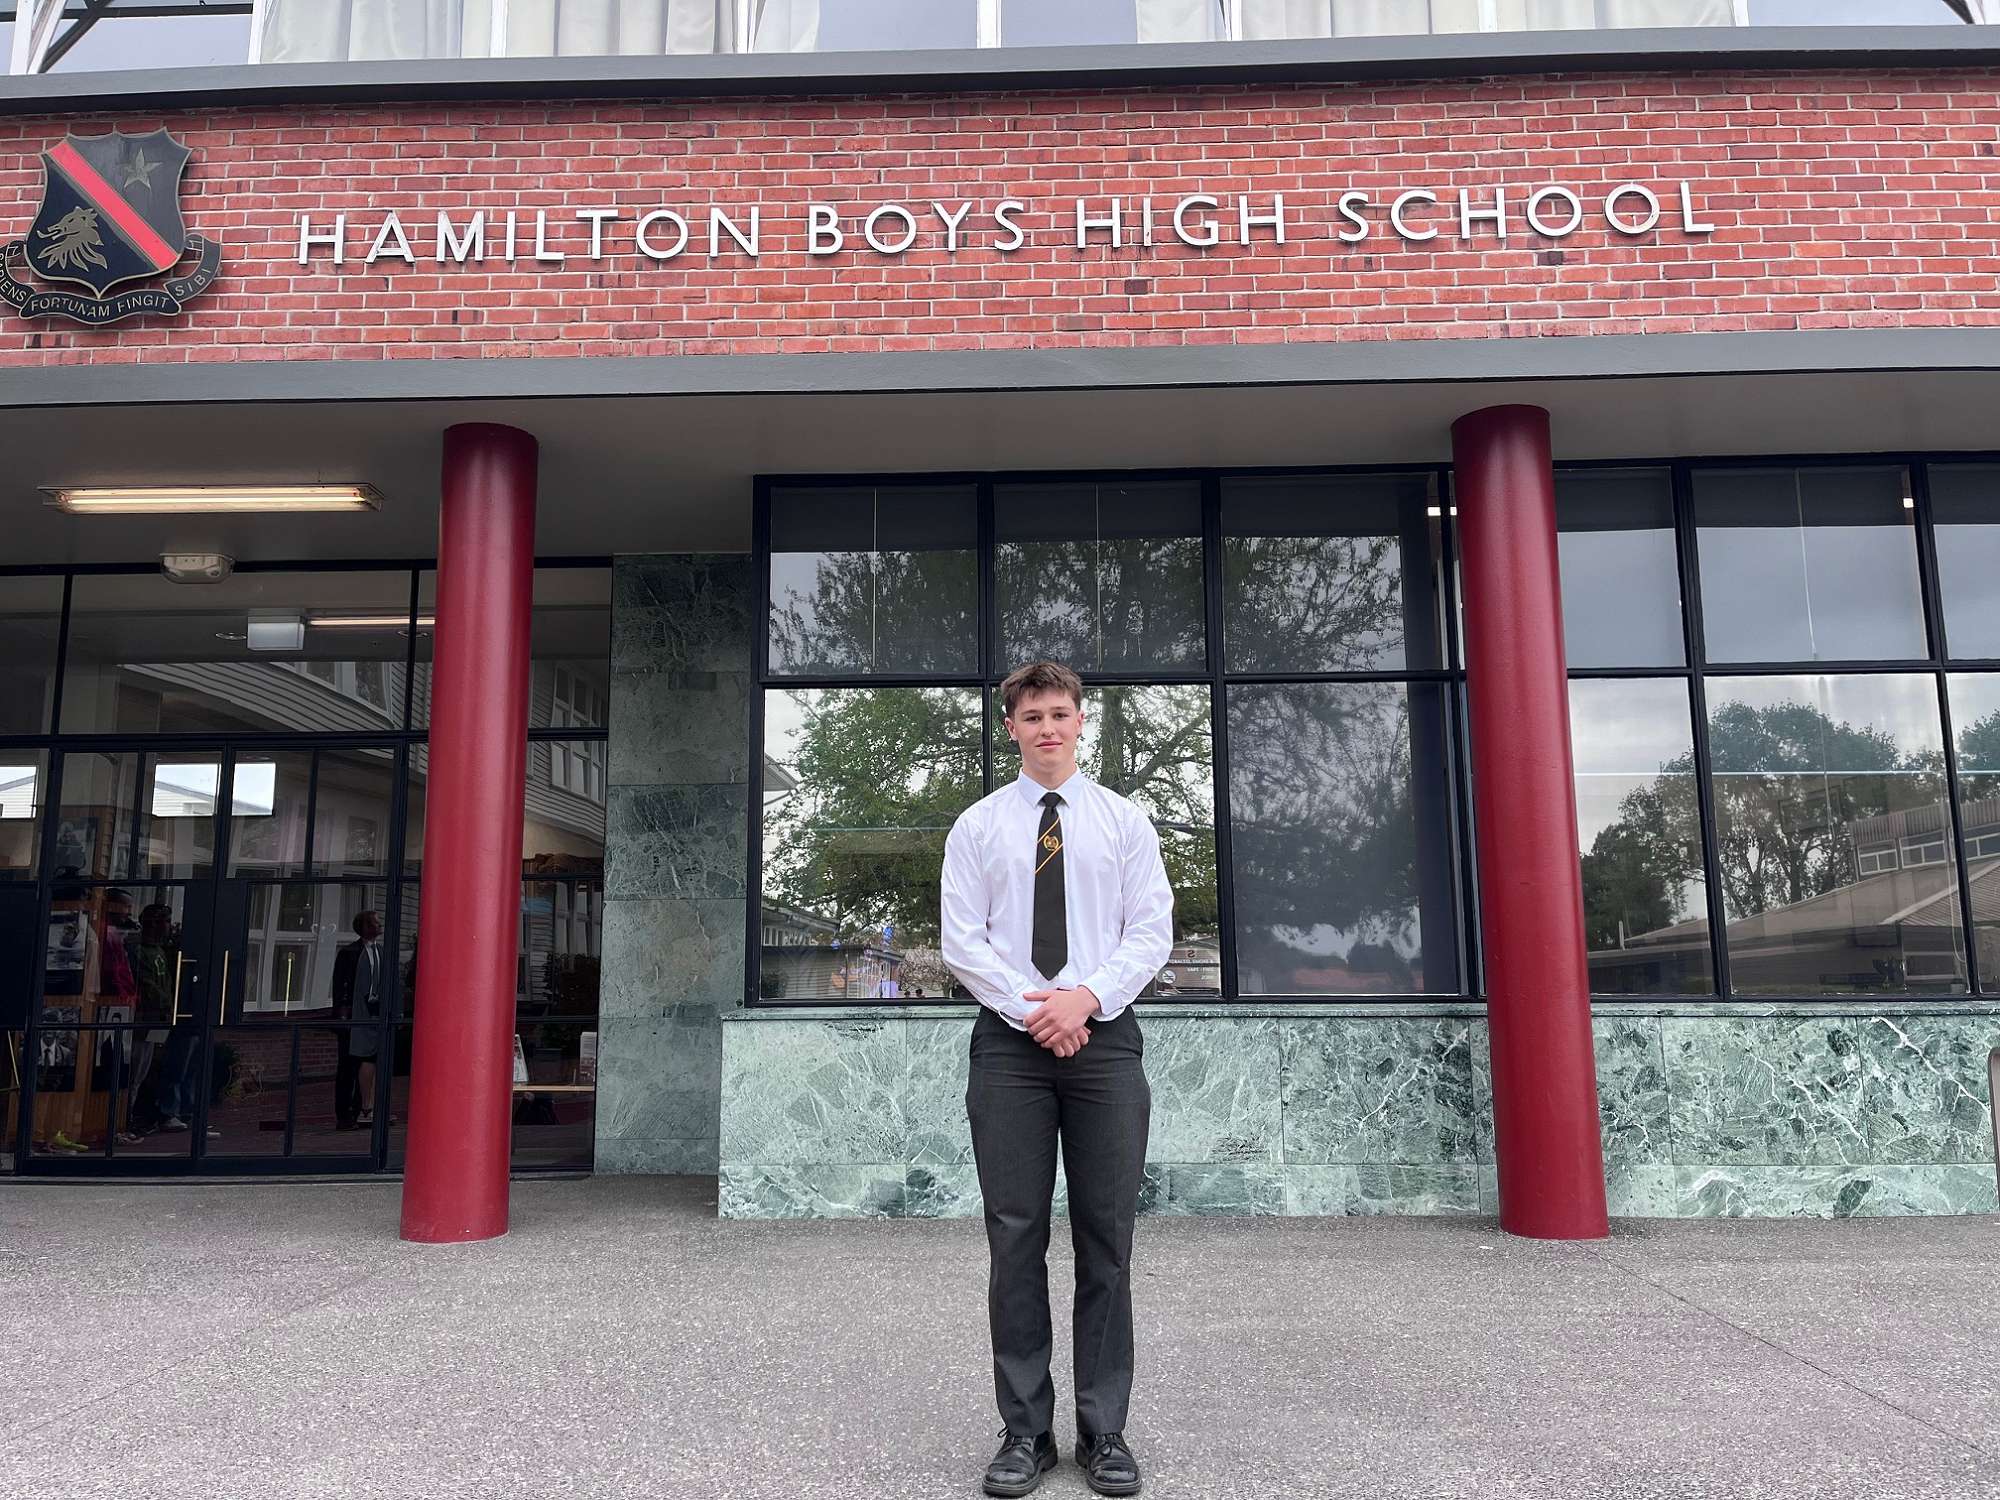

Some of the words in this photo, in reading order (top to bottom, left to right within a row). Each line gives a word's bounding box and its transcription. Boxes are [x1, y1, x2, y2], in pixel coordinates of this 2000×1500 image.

[299, 207, 759, 265] HAMILTON
[808, 201, 1024, 255] BOYS
[1076, 193, 1285, 250] HIGH
[1338, 181, 1716, 243] SCHOOL
[0, 252, 27, 302] PIENS
[30, 296, 111, 318] FORTUNAM
[117, 294, 169, 313] FINGIT
[174, 268, 212, 298] SIBI
